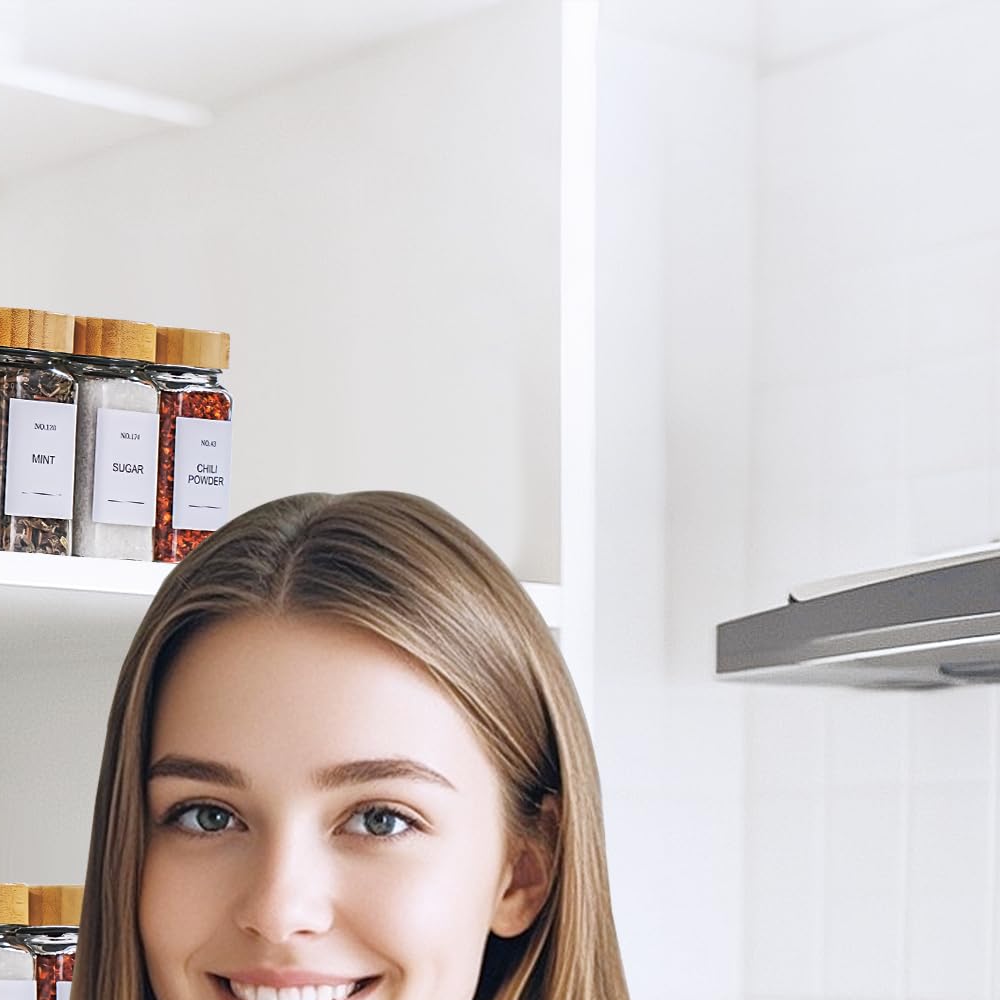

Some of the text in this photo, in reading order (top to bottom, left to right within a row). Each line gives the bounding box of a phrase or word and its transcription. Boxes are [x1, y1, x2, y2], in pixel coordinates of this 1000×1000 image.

[32, 454, 55, 464] MINT
[113, 463, 144, 474] SUGAR
[197, 464, 217, 473] CHILI
[188, 475, 224, 486] POWDER
